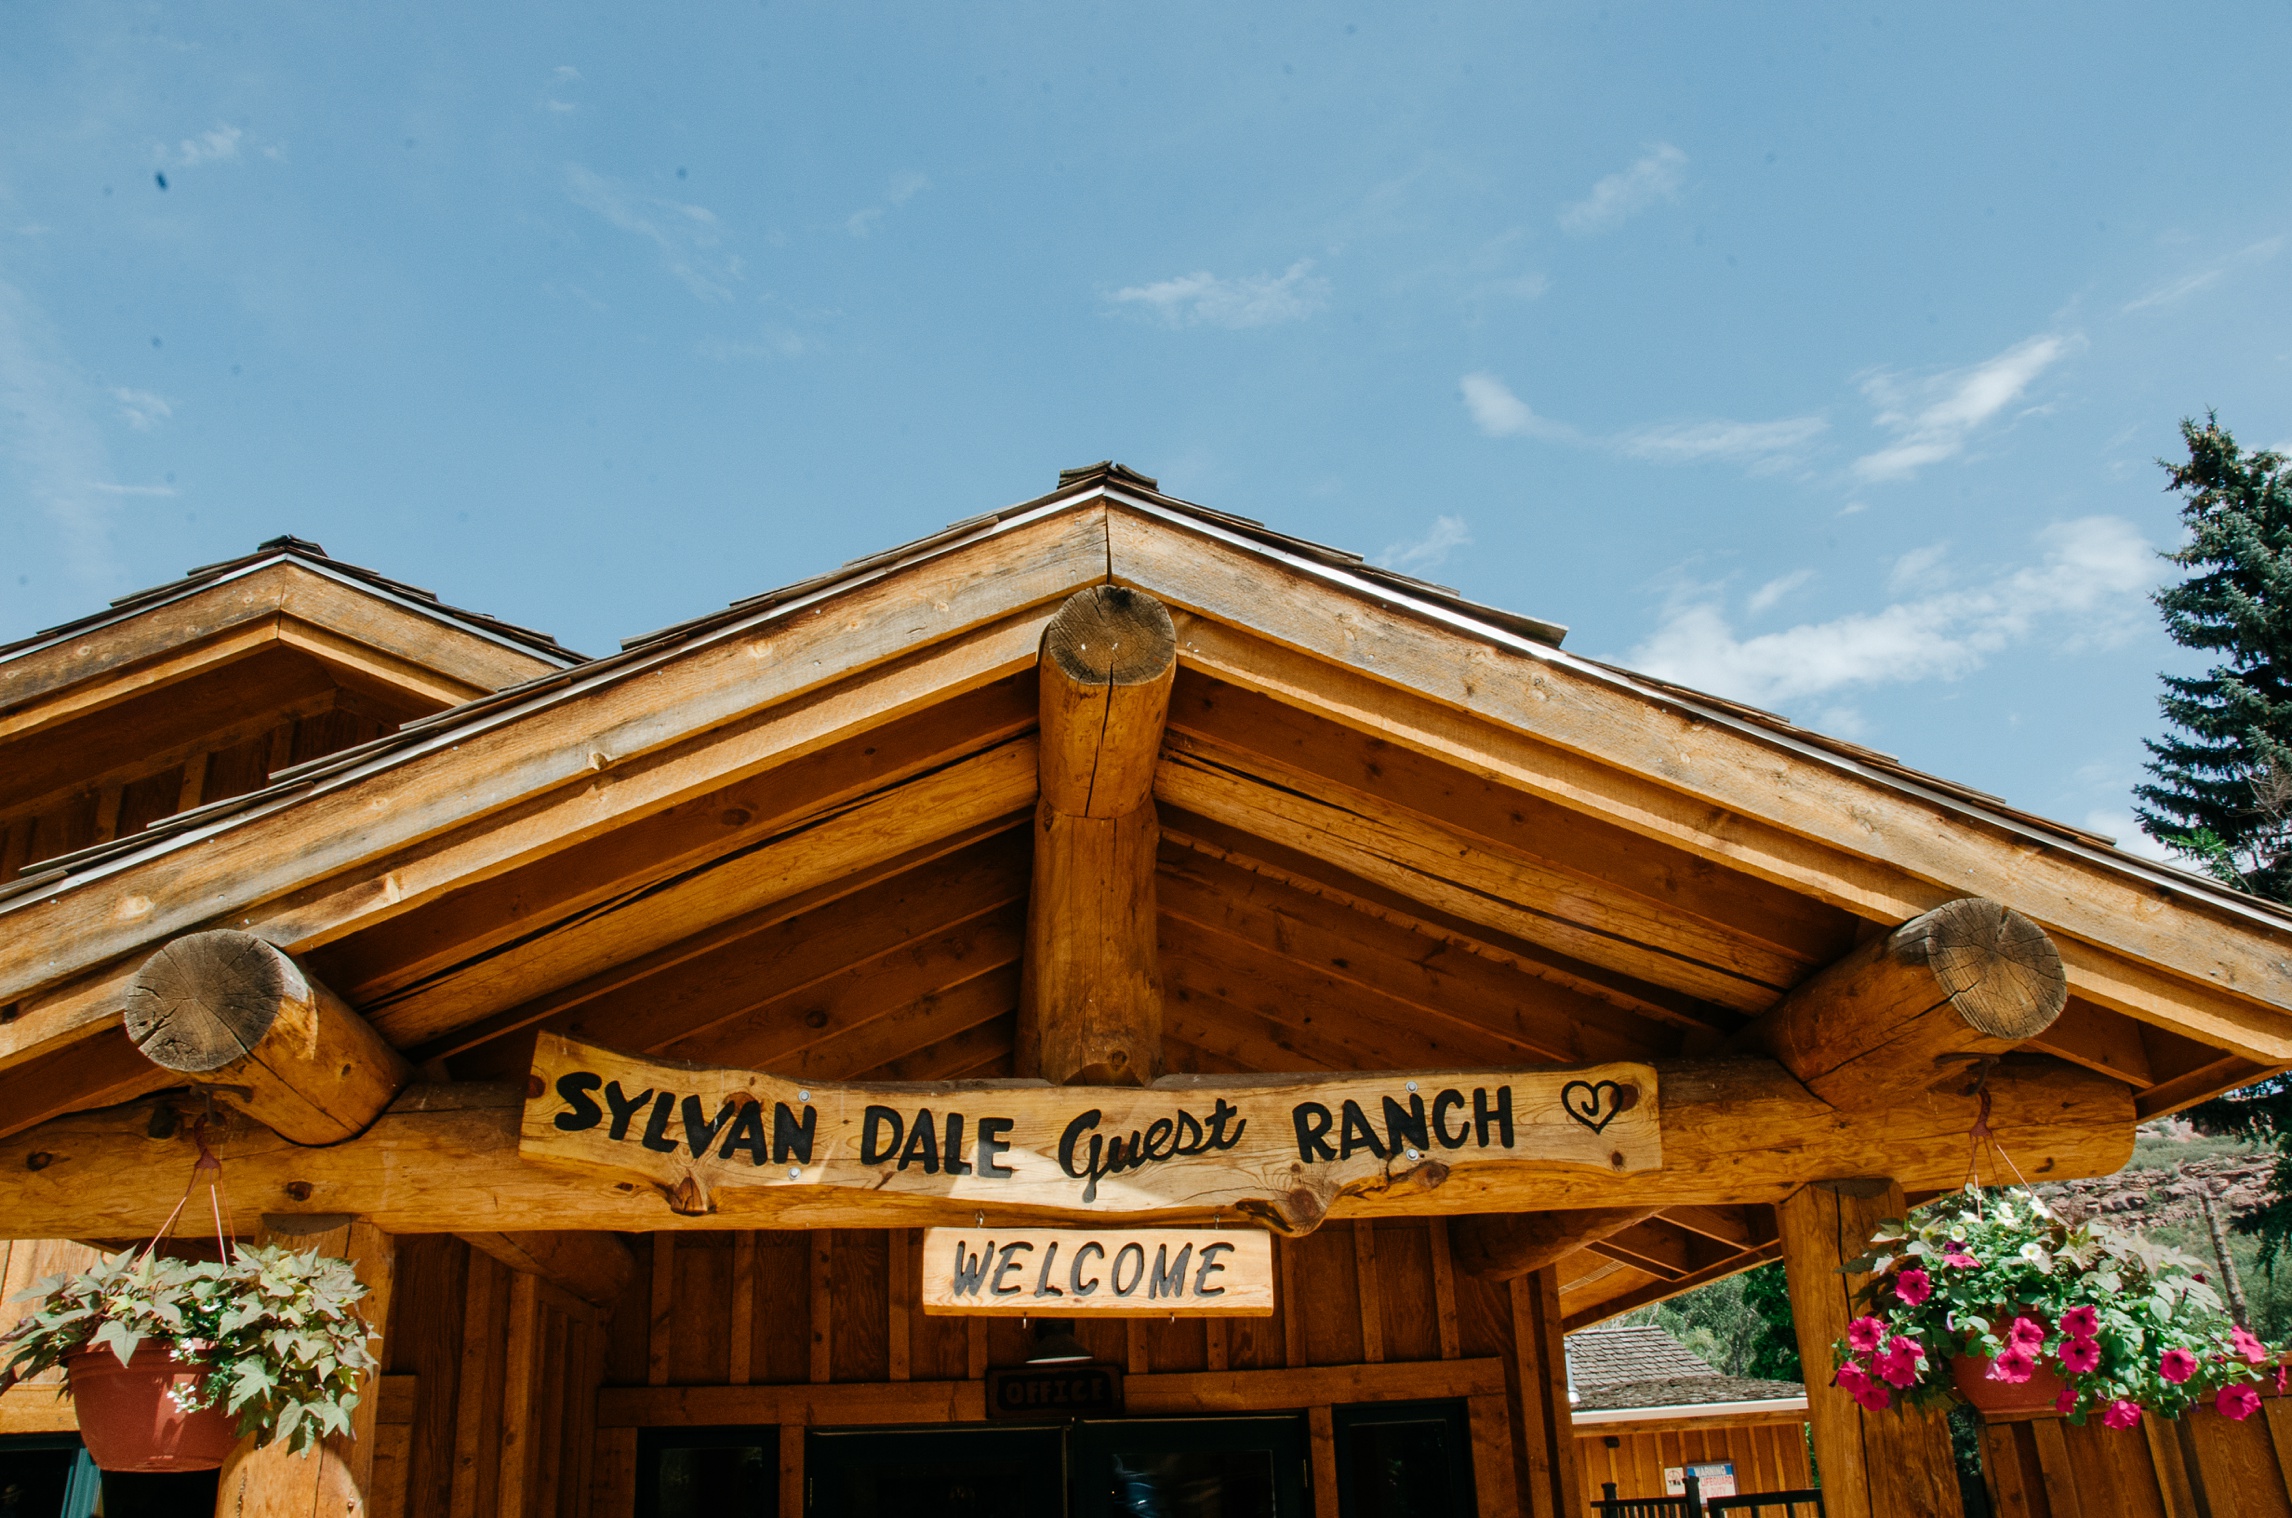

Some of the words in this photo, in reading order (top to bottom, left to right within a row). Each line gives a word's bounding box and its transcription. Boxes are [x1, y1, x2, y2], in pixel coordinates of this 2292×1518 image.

[554, 1071, 817, 1167] SYLVAN
[860, 1105, 1015, 1179] DALE
[1058, 1098, 1247, 1203] Guest
[1292, 1085, 1515, 1164] RANCH
[953, 1240, 1235, 1298] WELCOME
[1006, 1378, 1104, 1405] OFFICE
[1694, 1465, 1726, 1477] WARNING
[1701, 1475, 1733, 1487] LIFEGUARD
